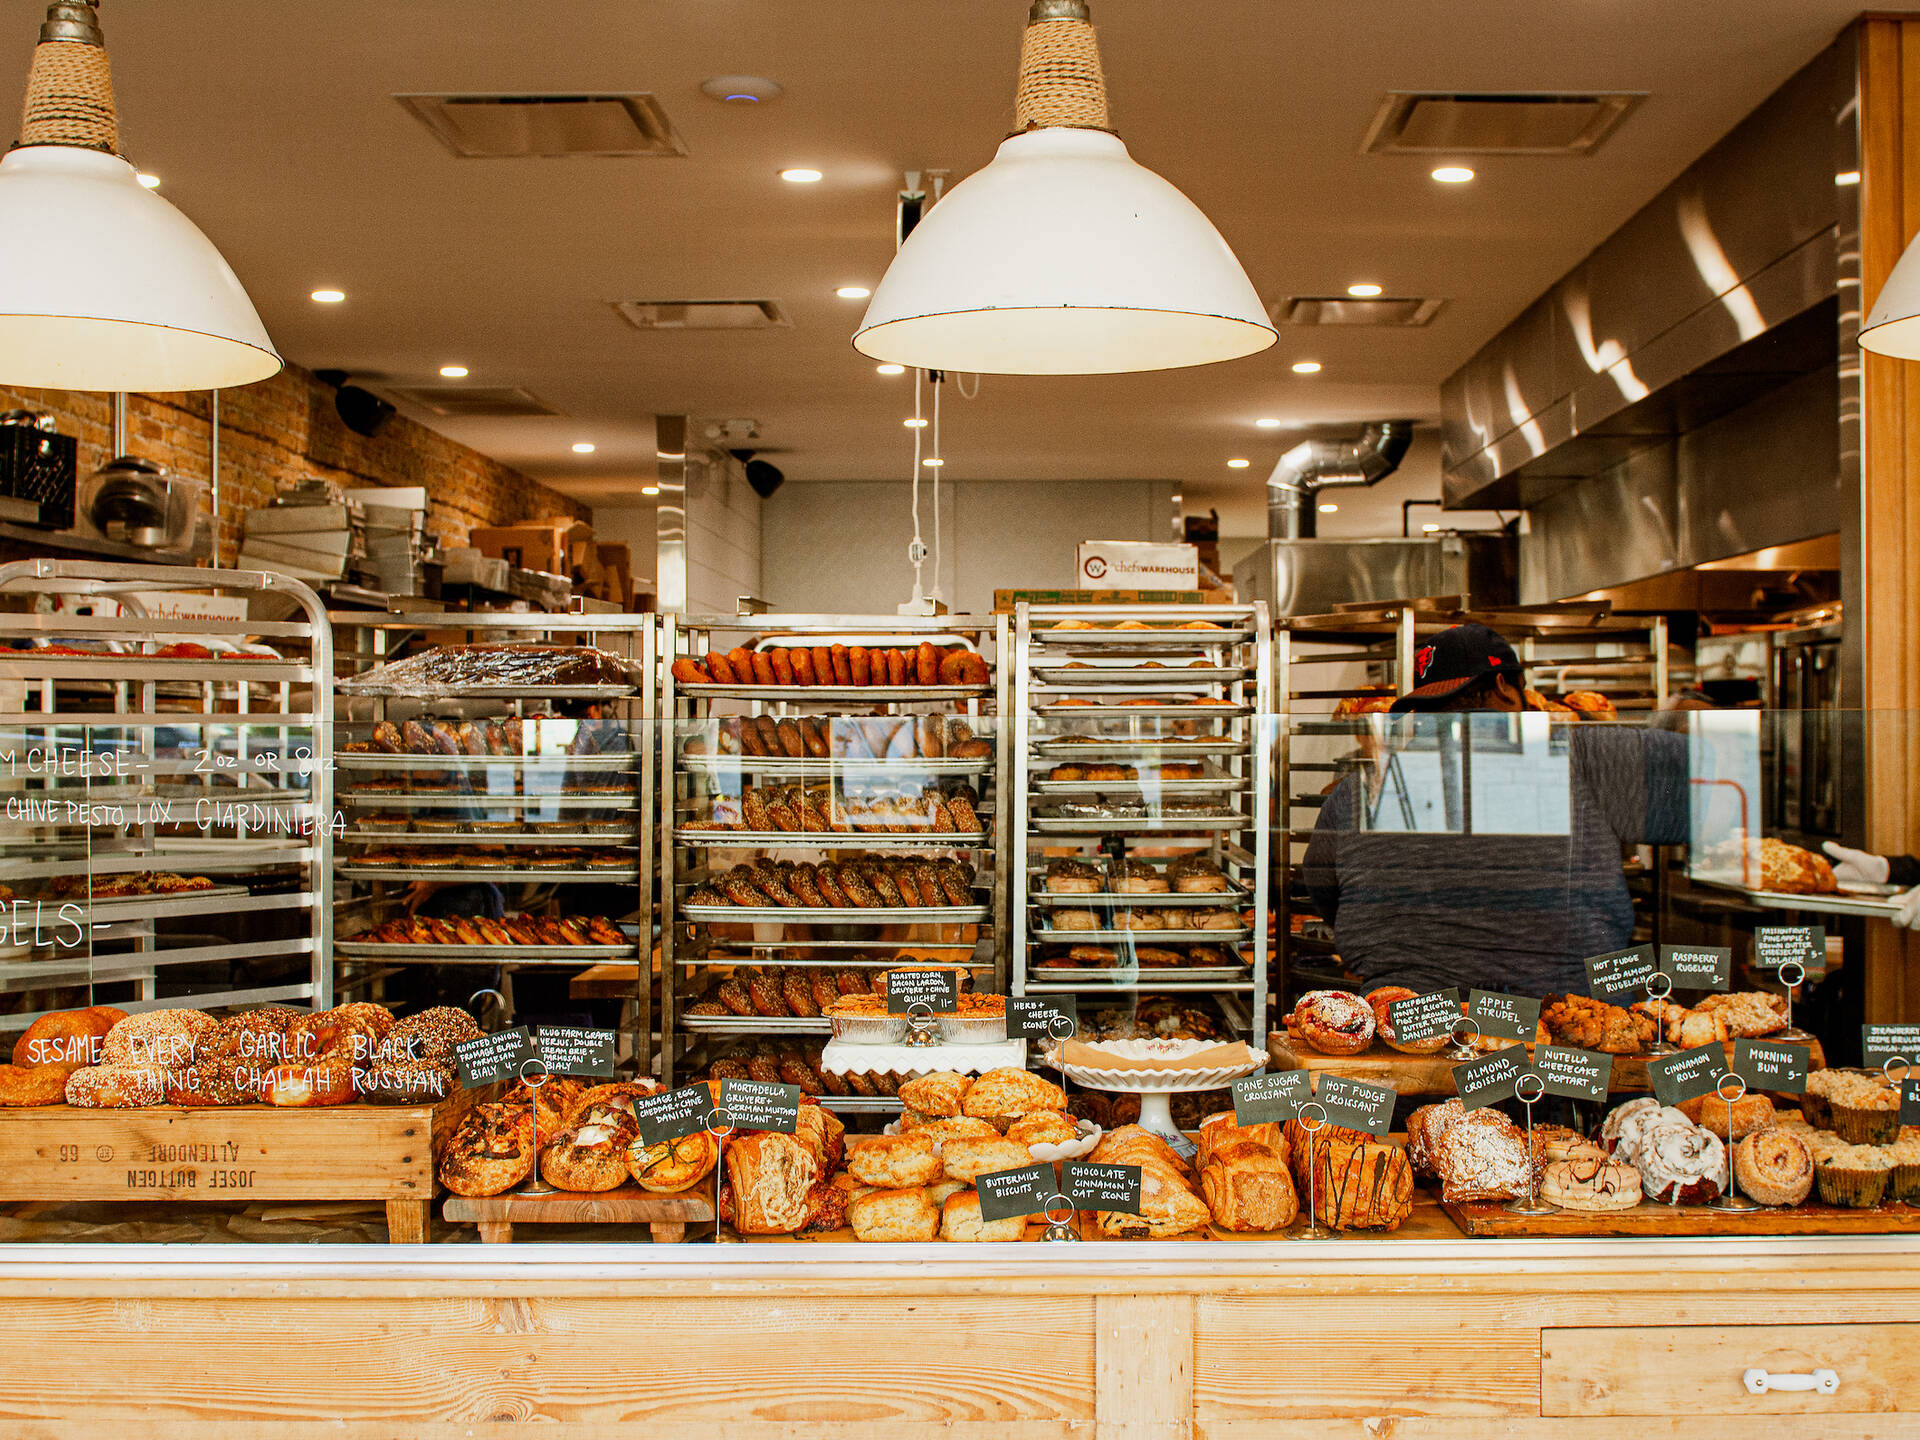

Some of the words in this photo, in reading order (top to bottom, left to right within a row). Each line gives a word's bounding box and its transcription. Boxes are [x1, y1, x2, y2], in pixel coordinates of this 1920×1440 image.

[254, 751, 281, 771] OR
[6, 796, 60, 823] CHIVE
[64, 799, 130, 832] PESTO,
[136, 800, 181, 831] LOX,
[195, 798, 348, 840] GIARDINIERA
[1592, 960, 1610, 971] HOT
[1612, 954, 1640, 967] FUDGE
[1672, 951, 1720, 965] RASPBERRY
[891, 972, 921, 980] ROASTED
[1593, 973, 1622, 985] SMOKED
[1622, 964, 1653, 978] ALMOND
[1676, 962, 1715, 973] RUGELACH
[1605, 974, 1647, 993] RUGELACH
[903, 994, 937, 1003] QUICHE
[1013, 1002, 1037, 1011] HERB
[1479, 996, 1514, 1010] APPLE
[1027, 1009, 1059, 1019] CHEESE
[1392, 1006, 1420, 1019] HONEY
[1423, 999, 1456, 1012] RICOTTA,
[1395, 1016, 1414, 1026] FIGS
[1421, 1009, 1449, 1021] BROWN
[1476, 1007, 1521, 1023] STRUDEL
[1022, 1020, 1048, 1030] SCONE
[1402, 1020, 1430, 1032] BUTTER
[1402, 1026, 1434, 1040] DANISH
[456, 1038, 490, 1054] ROASTED
[492, 1031, 522, 1045] ONION,
[539, 1028, 560, 1037] KLUG
[560, 1028, 583, 1039] FARM
[584, 1030, 615, 1043] GRAPES,
[574, 1038, 604, 1048] DOUBLE
[27, 1034, 103, 1063] SESAME
[239, 1031, 316, 1059] GARLIC
[351, 1034, 421, 1063] BLACK
[459, 1046, 495, 1063] FROMAGE
[496, 1039, 524, 1053] BLANC
[540, 1046, 567, 1055] CREAM
[568, 1047, 588, 1056] BRIE
[472, 1051, 515, 1068] PARMESAN
[1545, 1049, 1589, 1065] NUTELLA
[1663, 1052, 1711, 1076] CINNAMON
[1749, 1047, 1793, 1064] MORNING
[470, 1064, 497, 1081] BIALY
[545, 1060, 572, 1071] BIALY
[1467, 1058, 1510, 1081] ALMOND
[1538, 1060, 1600, 1078] CHEESECAKE
[1757, 1061, 1779, 1074] BUN
[129, 1068, 200, 1093] THING
[234, 1065, 331, 1093] CHALLAH
[350, 1065, 444, 1097] RUSSIAN
[1236, 1079, 1264, 1092] CANE
[1267, 1073, 1302, 1088] SUGAR
[1464, 1065, 1519, 1094] CROISSANT
[1547, 1073, 1590, 1087] POPTART
[1676, 1069, 1700, 1083] ROLL
[725, 1092, 767, 1105] GRUYERE
[728, 1081, 788, 1099] MORTADELLA,
[1243, 1086, 1294, 1103] CROISSANT
[1325, 1080, 1348, 1094] HOT
[1352, 1085, 1386, 1103] FUDGE
[727, 1103, 764, 1113] GERMAN
[764, 1106, 797, 1116] MUSTARD
[1325, 1093, 1380, 1113] CROISSANT
[655, 1107, 693, 1124] DANISH
[726, 1112, 773, 1123] CROISSANT
[147, 1144, 240, 1162] ALTENDORF
[208, 1170, 256, 1188] JOSEF
[985, 1170, 1040, 1188] BUTTERMILK
[1070, 1166, 1126, 1180] CHOCOLATE
[995, 1183, 1033, 1198] BISCUITS
[1074, 1179, 1125, 1190] CINNAMON
[1072, 1189, 1095, 1199] OAT
[1100, 1190, 1131, 1202] SCONE
